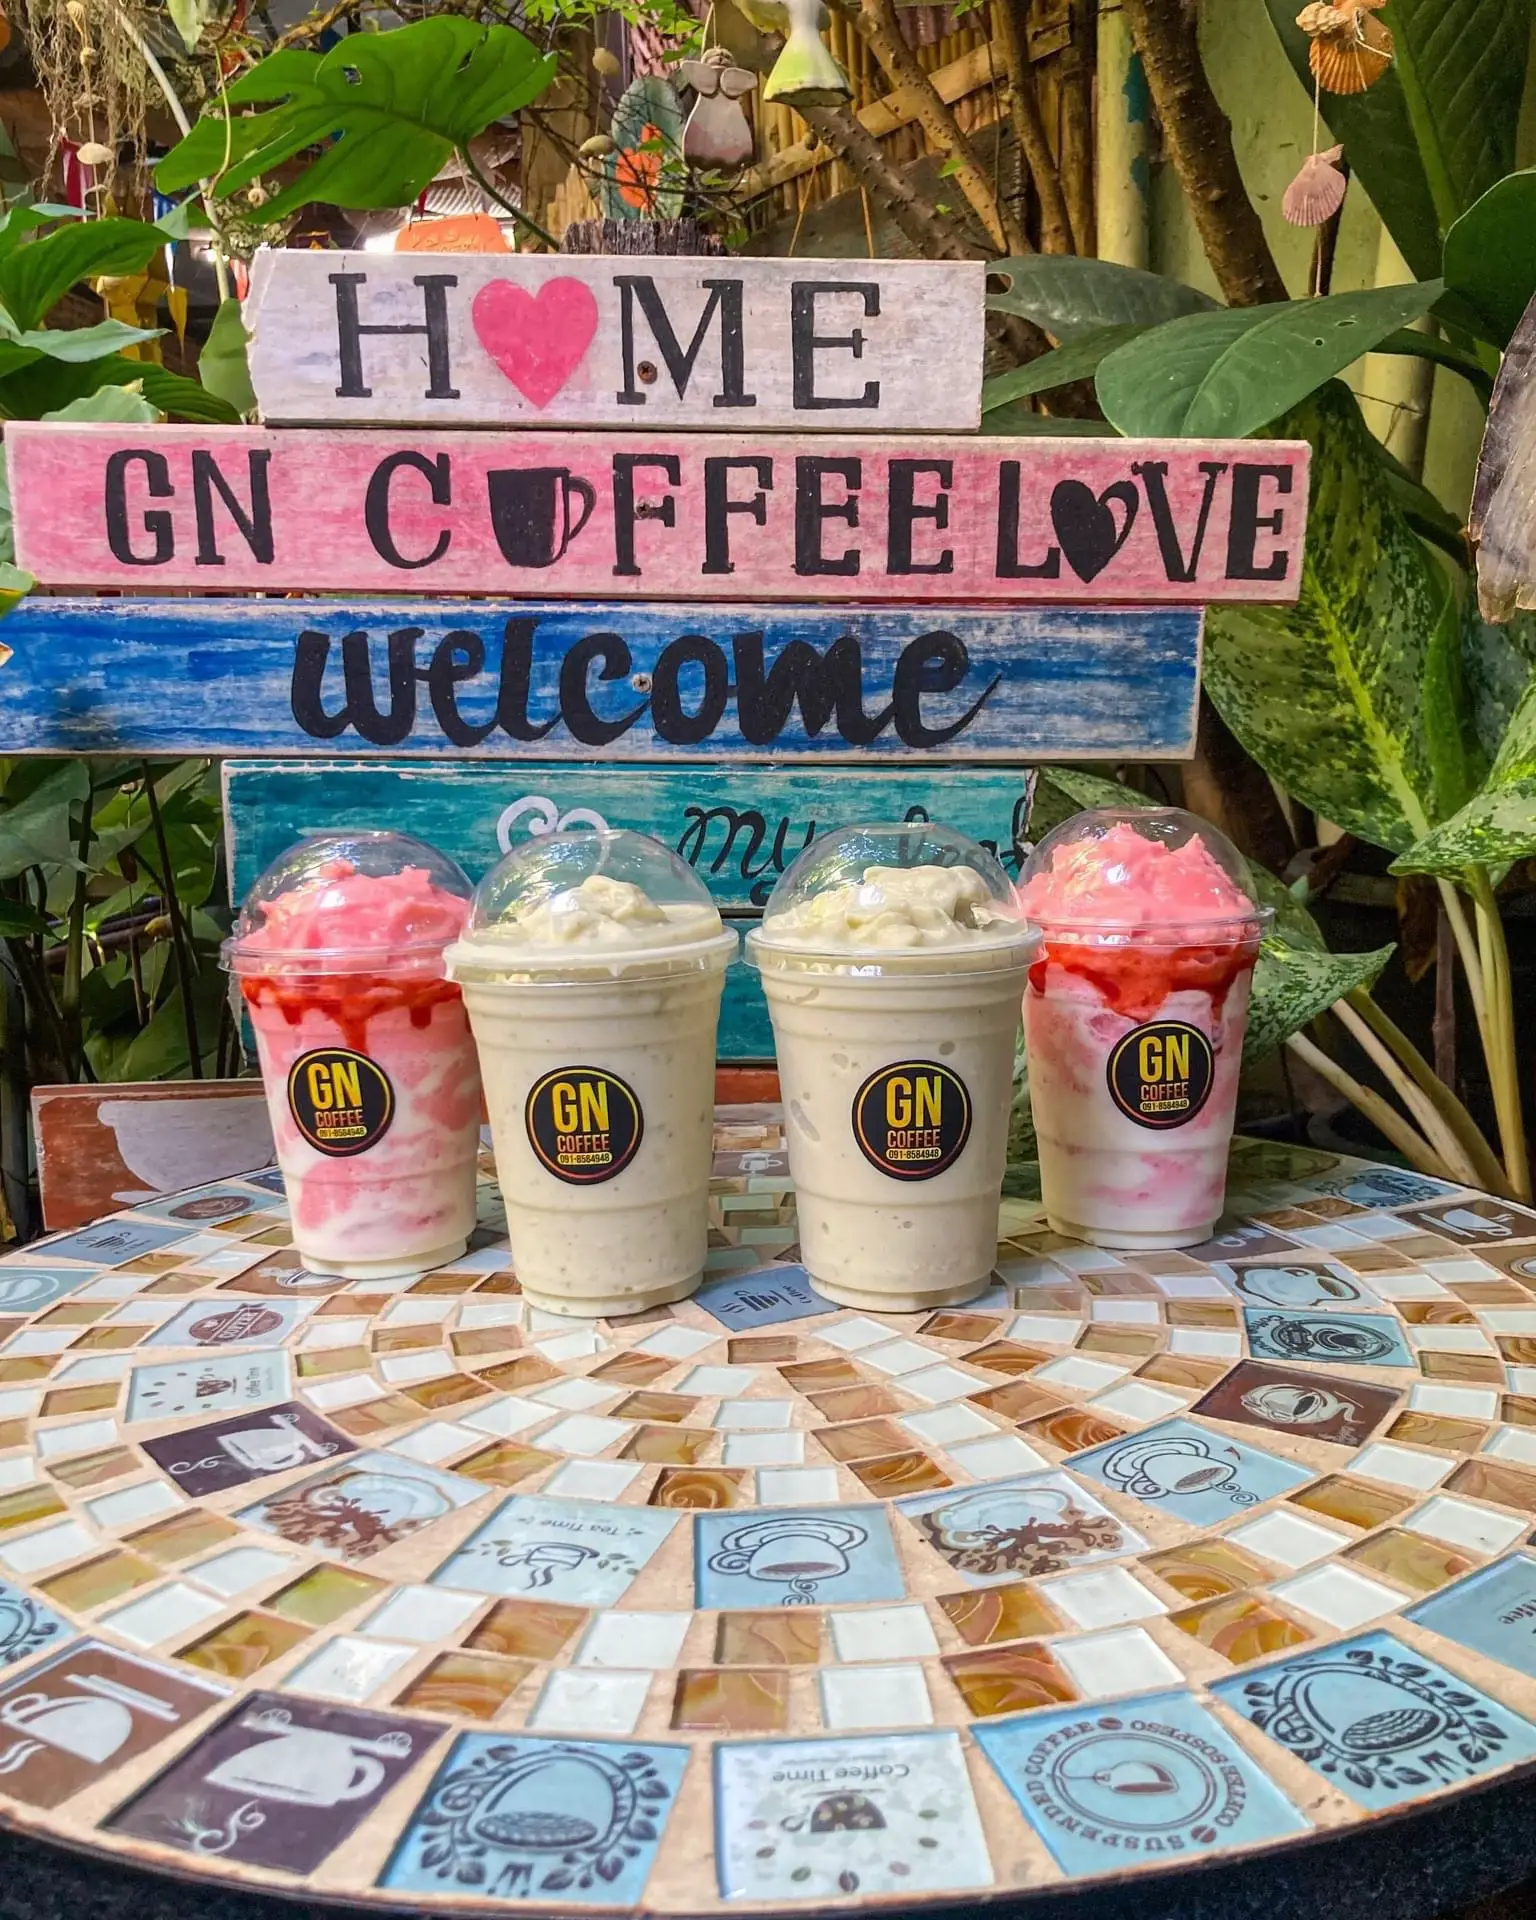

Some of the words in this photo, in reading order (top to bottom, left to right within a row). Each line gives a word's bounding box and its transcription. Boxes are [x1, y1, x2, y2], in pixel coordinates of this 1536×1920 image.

[105, 448, 274, 566] GN
[290, 617, 1002, 748] welcome
[1139, 1033, 1190, 1083] GN
[307, 1061, 364, 1110] GN
[552, 1081, 610, 1133] GN
[886, 1075, 942, 1128] GN
[1140, 1081, 1190, 1101] COFFEE
[315, 1109, 365, 1128] COFFEE
[887, 1128, 941, 1148] COFFEE
[556, 1133, 610, 1153] COFFEE
[540, 1518, 584, 1533] Time
[590, 1524, 620, 1536] Tea
[1024, 1720, 1095, 1776] COFFEE
[1129, 1719, 1229, 1764] SOSPESO
[772, 1770, 831, 1783] Time
[833, 1762, 911, 1782] Coffee
[1025, 1780, 1186, 1851] SUSPENDED
